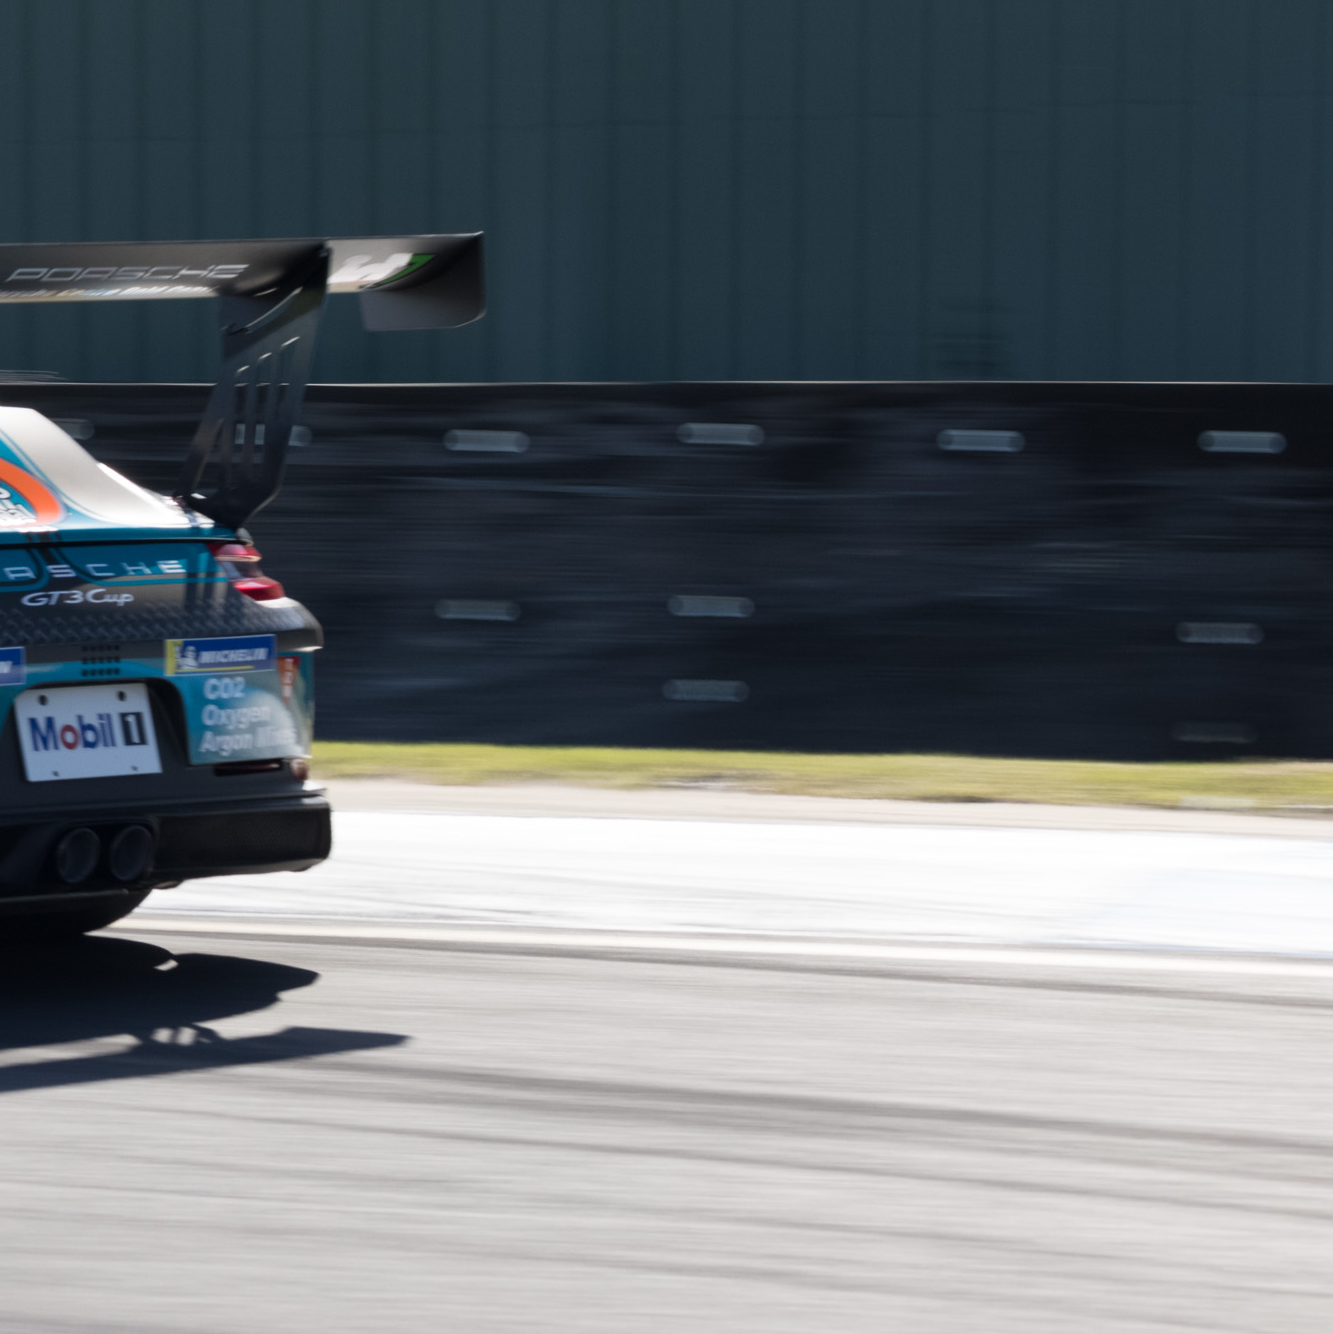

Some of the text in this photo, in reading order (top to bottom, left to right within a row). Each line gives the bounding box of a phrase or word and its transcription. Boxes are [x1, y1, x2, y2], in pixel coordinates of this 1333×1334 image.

[4, 264, 250, 283] PORSCHE
[199, 647, 269, 664] MICHELIN
[202, 676, 246, 700] CO2
[200, 703, 271, 730] Oxygen
[29, 712, 144, 753] Mobil 1
[198, 730, 254, 757] Argon
